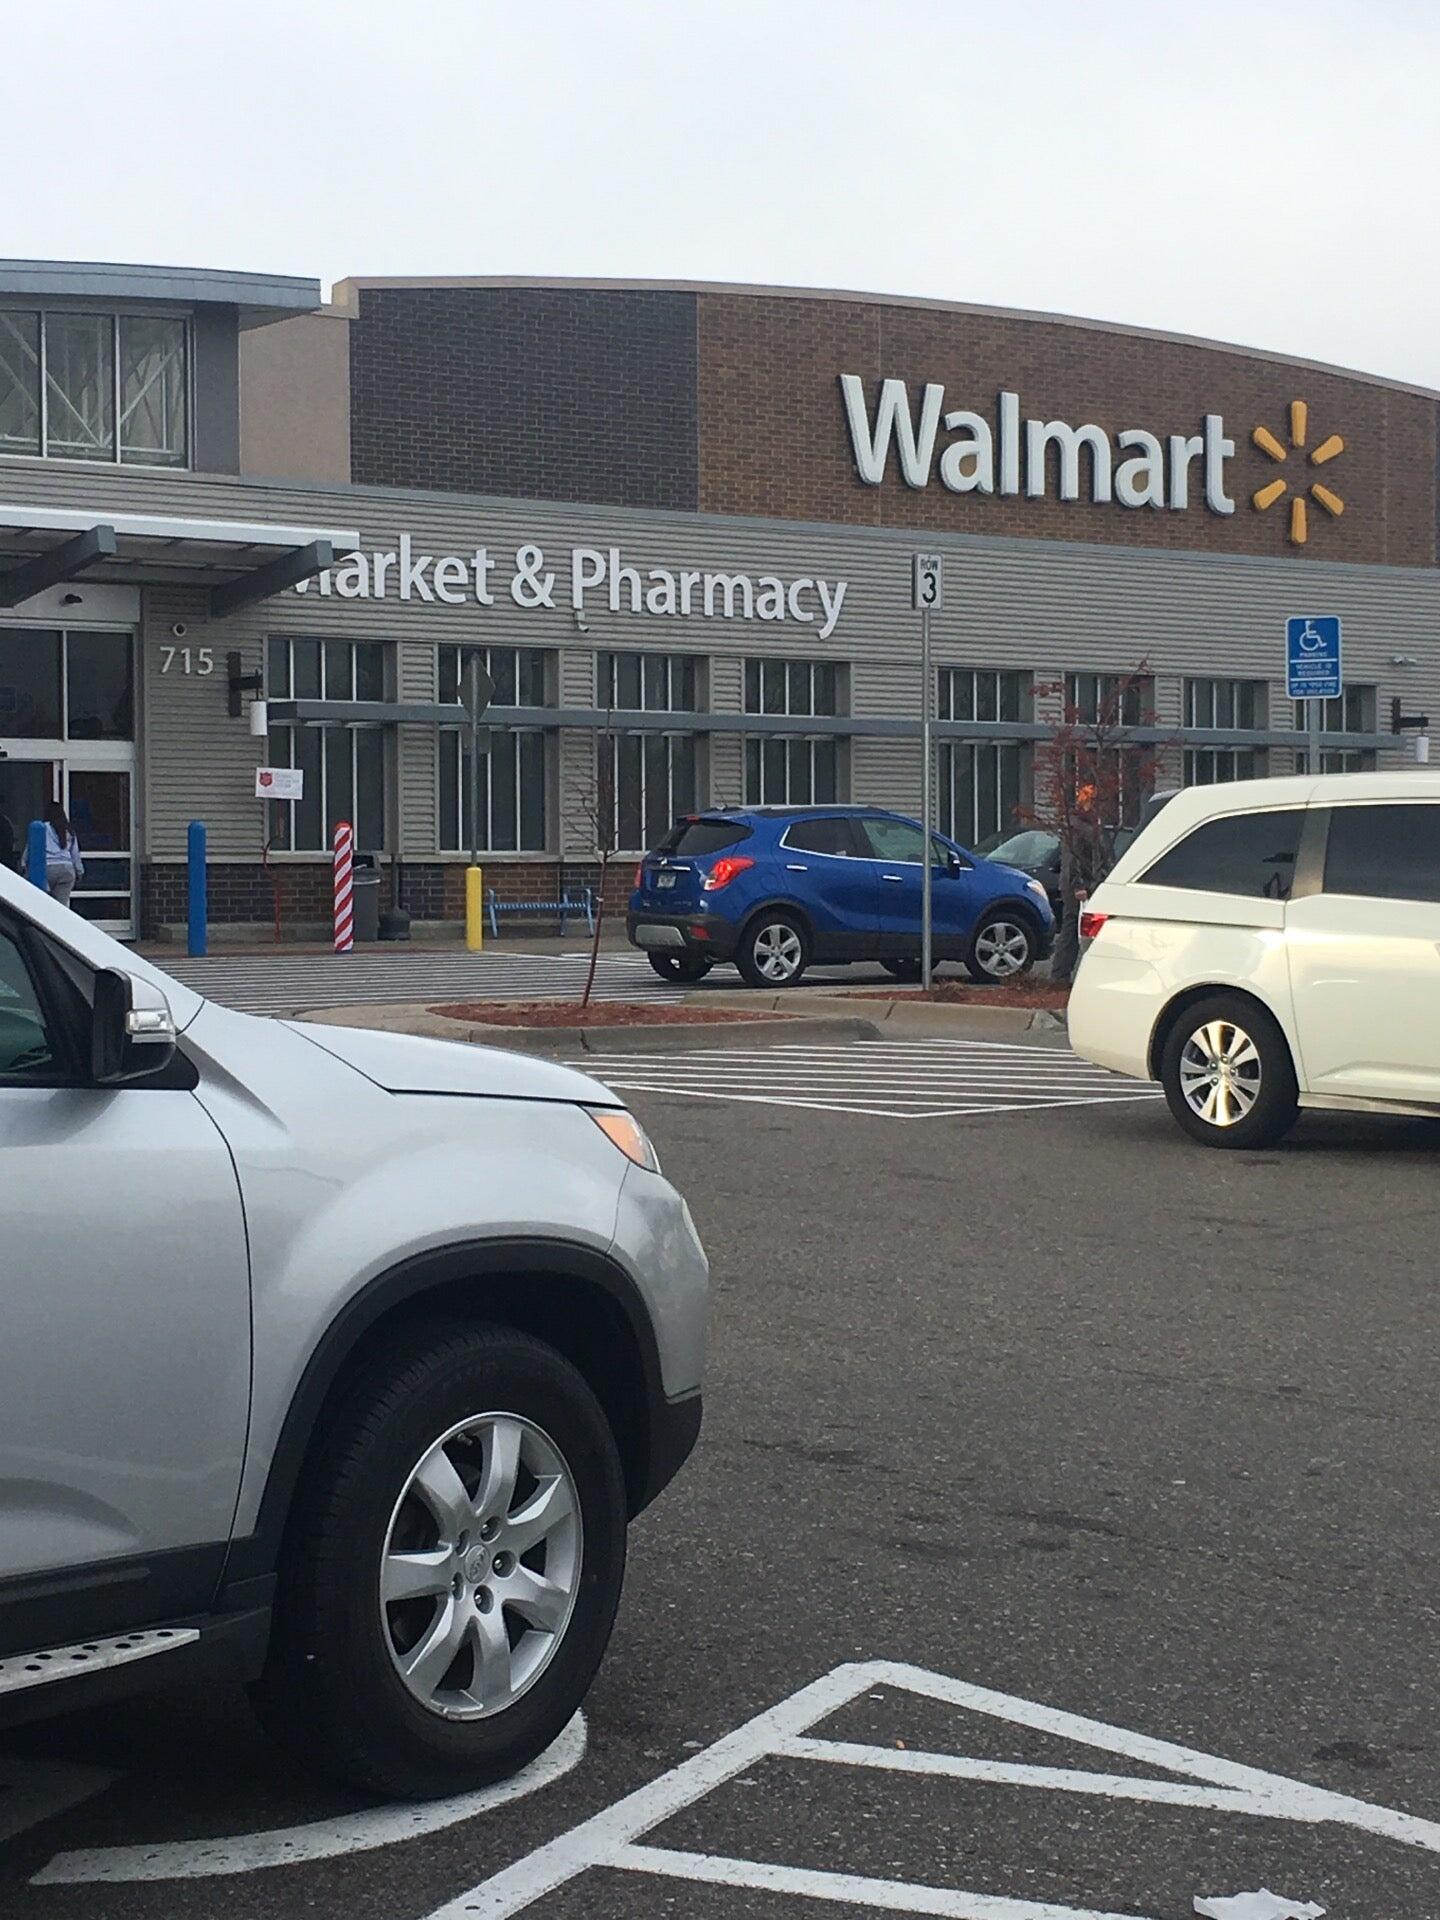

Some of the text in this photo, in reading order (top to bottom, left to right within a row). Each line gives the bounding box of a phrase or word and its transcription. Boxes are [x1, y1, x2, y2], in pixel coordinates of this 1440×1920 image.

[840, 373, 1236, 516] Walmart
[510, 545, 556, 608] &
[571, 548, 848, 640] Pharmacy
[922, 572, 937, 603] 3
[160, 646, 214, 675] 715
